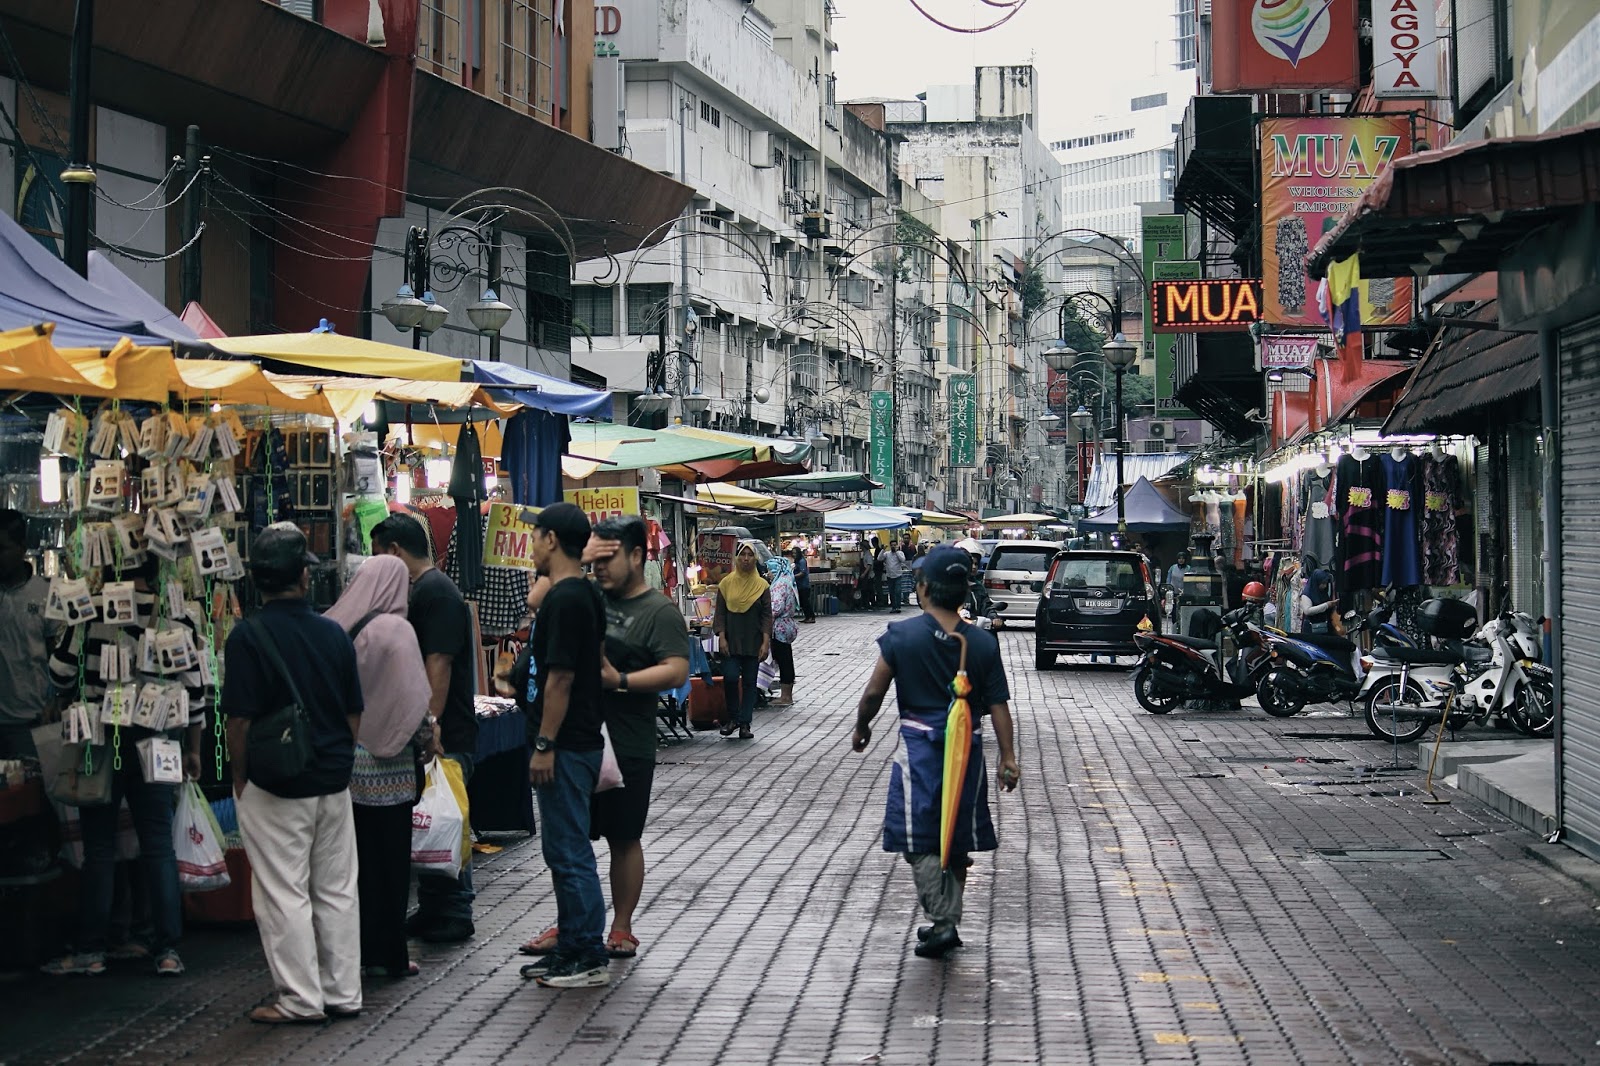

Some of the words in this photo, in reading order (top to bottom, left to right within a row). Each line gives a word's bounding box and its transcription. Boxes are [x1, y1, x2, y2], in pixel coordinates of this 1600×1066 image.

[1287, 186, 1364, 198] WHOLESA
[1293, 202, 1353, 213] EMPOR
[1166, 284, 1258, 322] MUA
[1268, 344, 1309, 355] MUAZ
[583, 493, 624, 509] Helai
[493, 530, 534, 559] RM
